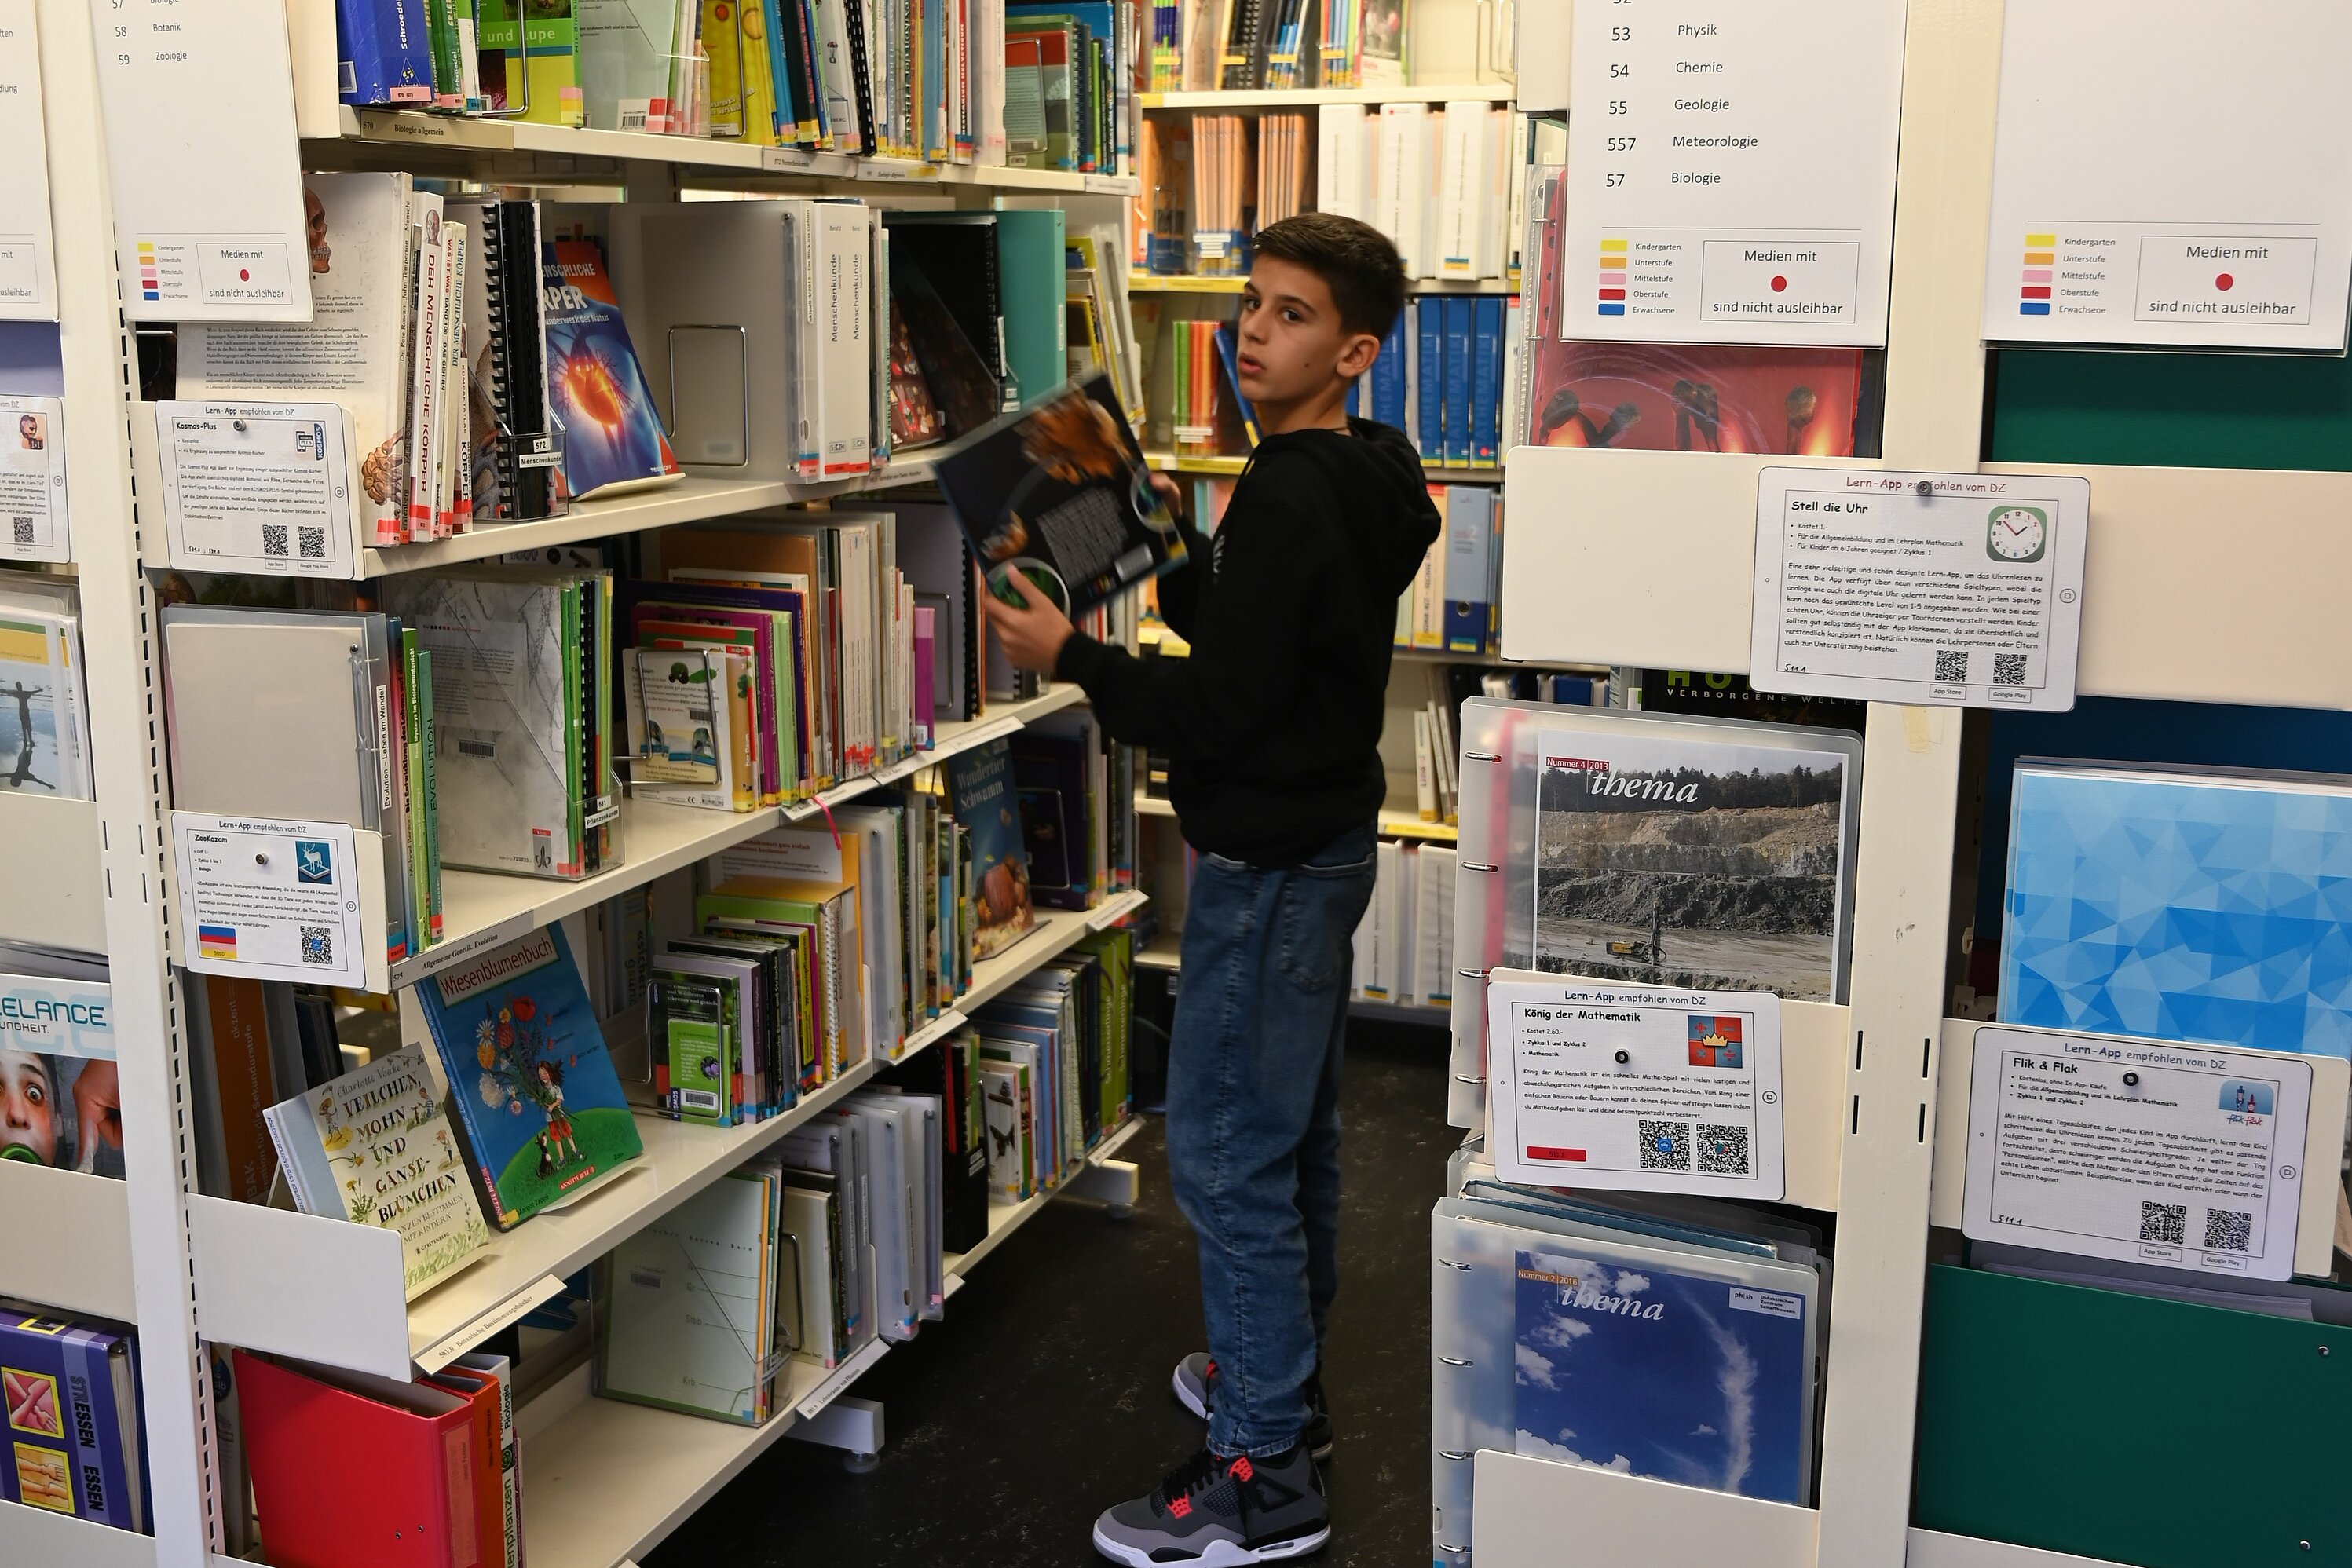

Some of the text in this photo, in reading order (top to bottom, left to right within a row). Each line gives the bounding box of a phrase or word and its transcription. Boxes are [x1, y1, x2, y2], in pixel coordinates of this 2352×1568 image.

[115, 23, 181, 38] 58 Botanik
[488, 29, 514, 42] und
[1611, 24, 1717, 42] 53 Physik
[119, 51, 188, 65] 59 Zoologie
[1610, 61, 1723, 78] 54 Chemie
[1608, 98, 1730, 115] 55 Geologie
[363, 121, 444, 137] 570 Biologie allgemein
[1607, 136, 1758, 152] 557 Meteorologie
[1606, 172, 1721, 188] 57 Biologie
[1635, 243, 1681, 252] Kindergarten
[2065, 238, 2116, 248] Kindergarten
[221, 250, 264, 259] Medien mit
[1744, 250, 1816, 262] Medien mit
[2063, 254, 2105, 263] Unterstufe
[2186, 246, 2268, 258] Medien mit
[542, 263, 596, 277] ENSCHLICHE
[1635, 258, 1672, 267] Unterstufe
[2061, 272, 2105, 280] Mittelstufe
[210, 288, 284, 299] sind nicht ausleihbar
[453, 239, 465, 346] MENSCHLICHE KÖRPER
[543, 285, 588, 312] RPER
[2060, 288, 2099, 297] Oberstufe
[1714, 302, 1842, 315] sind nicht ausleihbar
[2058, 305, 2106, 314] Erwachsene
[2149, 300, 2296, 316] sind nicht ausleihbar
[423, 295, 434, 418] MENSCHLICHE
[205, 406, 237, 415] Lern-App
[176, 422, 217, 431] Kosmos-Plus
[535, 440, 547, 450] 572
[521, 455, 561, 466] Menschenkunde
[1846, 477, 2006, 493] Lern-App efohlen vom DZ
[1791, 502, 1868, 514] Stell die Uhr
[1821, 535, 1872, 544] Allgemeinbildung
[1897, 538, 1924, 546] Lehrplan
[409, 648, 418, 704] Biologieunterricht
[1667, 689, 1860, 705] VERBORGENE WELTE
[401, 740, 410, 797] Entwicklung
[427, 718, 437, 811] EVOLUTION
[1546, 758, 1576, 769] Nummer
[1591, 769, 1699, 804] thema
[961, 780, 1004, 812] Schwamm
[219, 821, 251, 830] Lern-App
[587, 810, 618, 825] Pflanzenkunde
[195, 834, 228, 843] ZooKazam
[393, 973, 403, 982] 575
[474, 934, 499, 948] Evolution
[440, 937, 553, 997] Wiesenblumenbuch
[1565, 990, 1614, 1003] Lern-App
[1619, 993, 1667, 1005] empfohlen
[1692, 996, 1706, 1006] DZ
[1525, 1009, 1641, 1022] König der Mathematik
[2065, 1043, 2227, 1070] Lern-App empfohlen vom DZ
[2014, 1058, 2078, 1074] Flik & Flak
[337, 1075, 375, 1098] Charlotte
[342, 1070, 422, 1119] VEILCHEN,
[356, 1106, 408, 1142] MOHN
[370, 1137, 406, 1163] UND
[375, 1157, 431, 1193] GÄNSE-
[378, 1171, 457, 1224] BLÜMCHEN
[422, 1194, 463, 1222] BESTIMMEN
[404, 1213, 452, 1245] MIT KINDERN
[1518, 1270, 1548, 1281] Nummer
[1560, 1281, 1664, 1321] thema
[1760, 1295, 1794, 1305] Didaktisches
[1760, 1304, 1796, 1314] Schaffhausen
[455, 1328, 485, 1347] Botanische
[70, 1375, 96, 1449] STRESSEN
[83, 1464, 104, 1511] ESSEN
